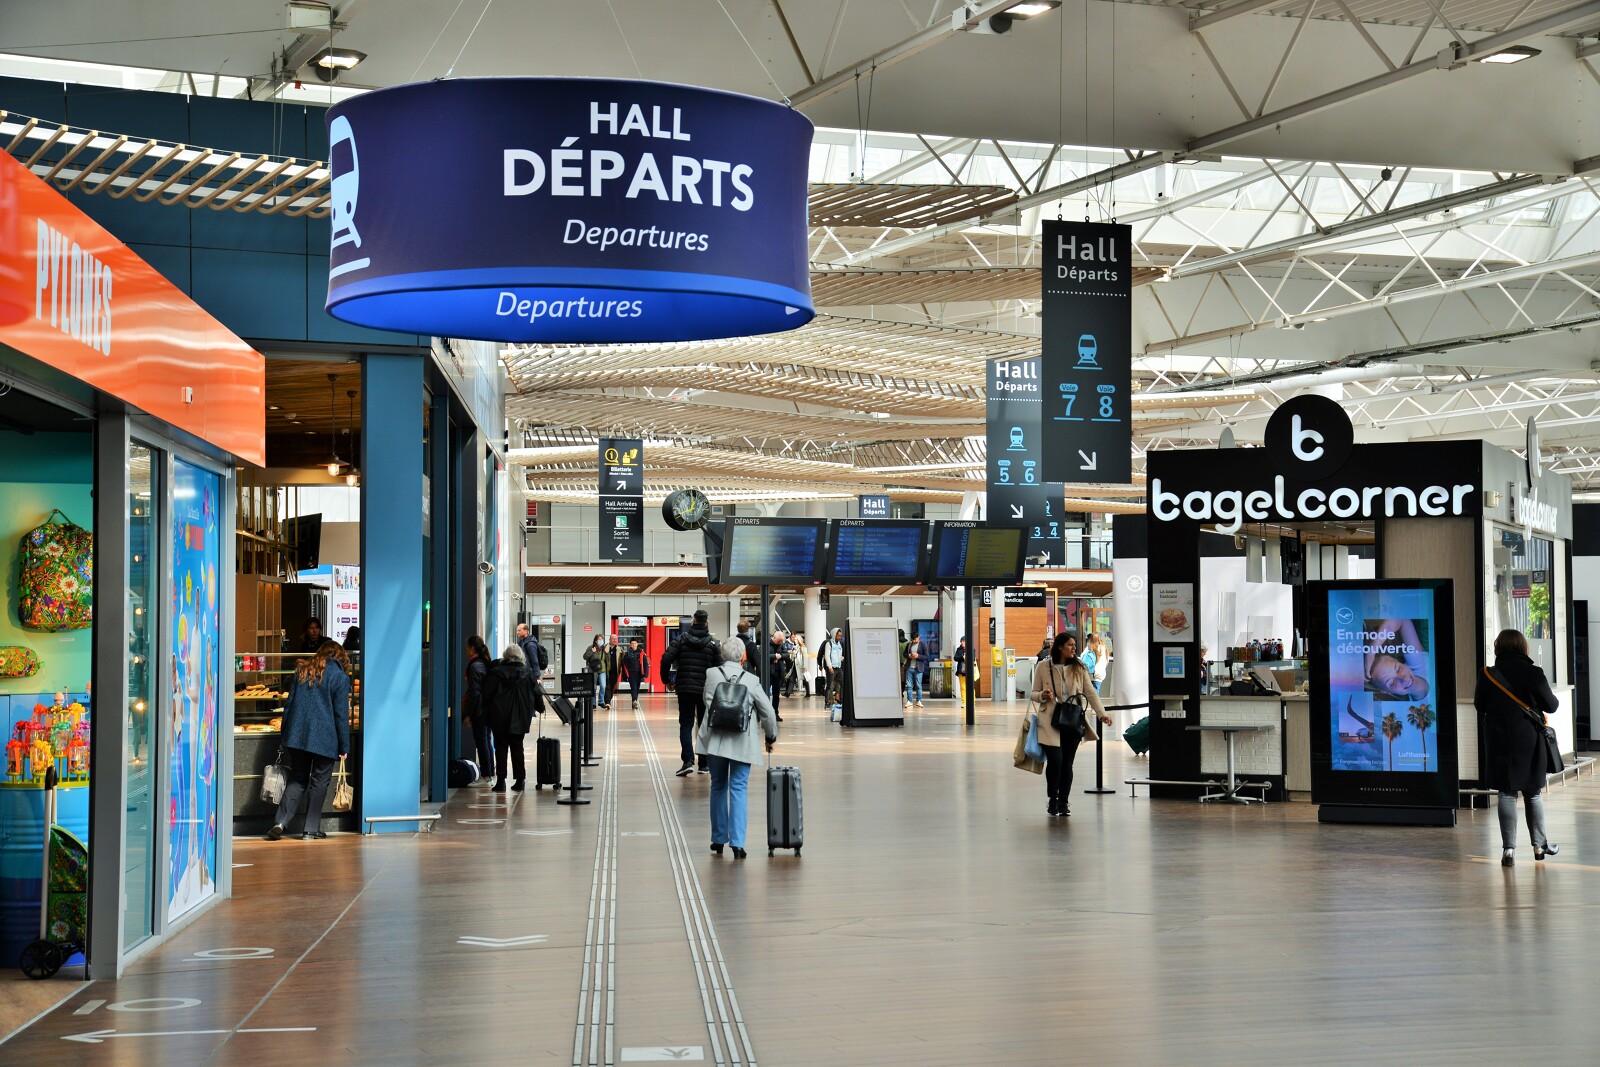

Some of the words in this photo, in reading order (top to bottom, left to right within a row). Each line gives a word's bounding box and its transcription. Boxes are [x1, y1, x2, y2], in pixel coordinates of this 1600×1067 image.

[589, 101, 691, 142] HALL
[503, 136, 754, 212] DÉPARTS
[563, 219, 709, 252] Departures
[1057, 234, 1118, 263] Hall
[1057, 265, 1118, 283] Départs
[35, 216, 113, 358] PYLONES
[495, 291, 643, 323] Departures
[995, 361, 1038, 379] Hall
[996, 380, 1038, 392] Départs
[1061, 384, 1077, 392] Voie
[1099, 385, 1114, 393] Voie
[1061, 394, 1076, 416] 7
[1099, 395, 1114, 418] 8
[1291, 413, 1325, 462] b
[1000, 467, 1010, 483] 5
[1024, 467, 1035, 483] 6
[863, 498, 886, 509] Hall
[863, 508, 886, 516] Départs
[1034, 526, 1041, 537] 3
[1050, 526, 1058, 537] 4
[956, 529, 969, 577] information
[1336, 628, 1354, 641] En
[1356, 628, 1396, 641] mode
[1336, 642, 1419, 655] découverte.
